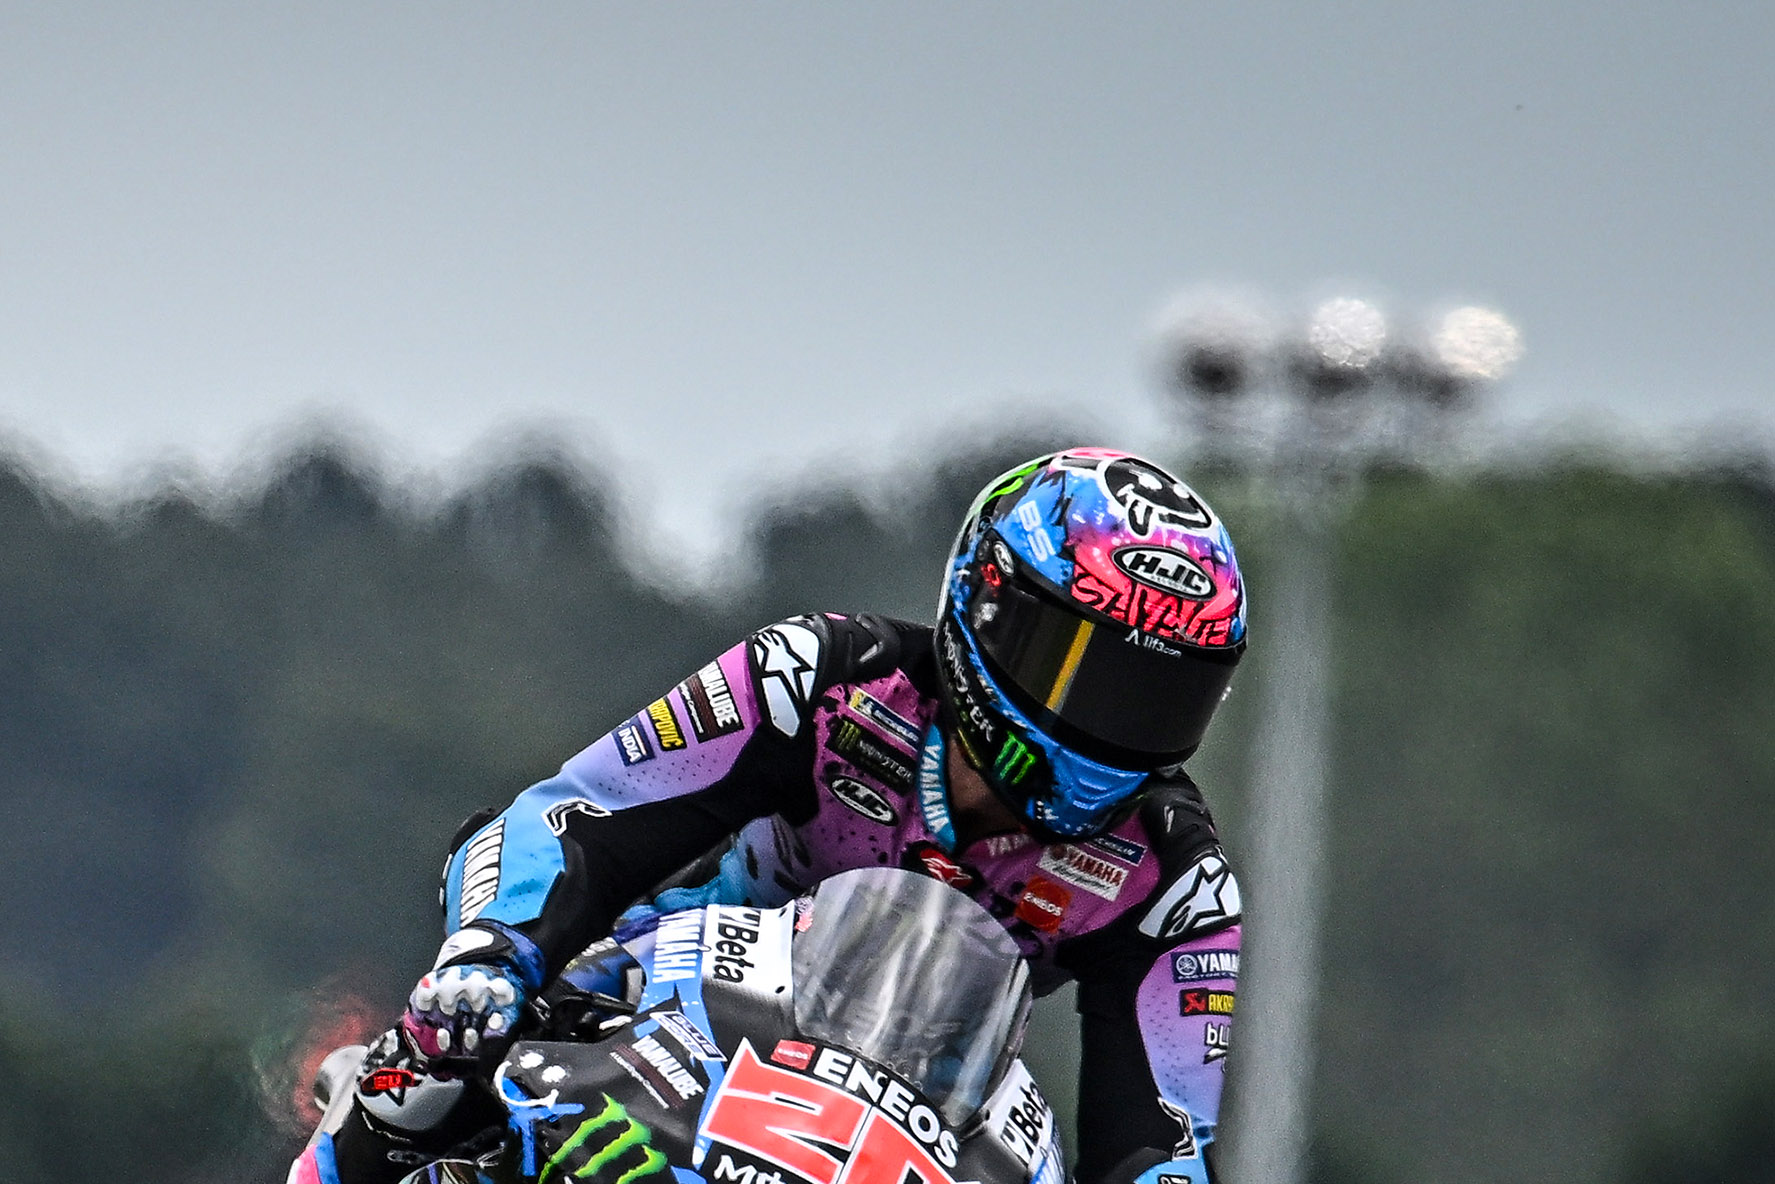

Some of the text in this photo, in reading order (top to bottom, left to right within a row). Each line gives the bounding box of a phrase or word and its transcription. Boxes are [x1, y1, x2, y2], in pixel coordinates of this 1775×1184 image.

[1128, 553, 1207, 592] HJC
[618, 728, 642, 763] INDIA
[921, 745, 949, 833] YAMAHA
[1069, 851, 1122, 886] YAMAHA
[713, 922, 758, 983] Beta
[813, 1047, 959, 1168] ENEOS
